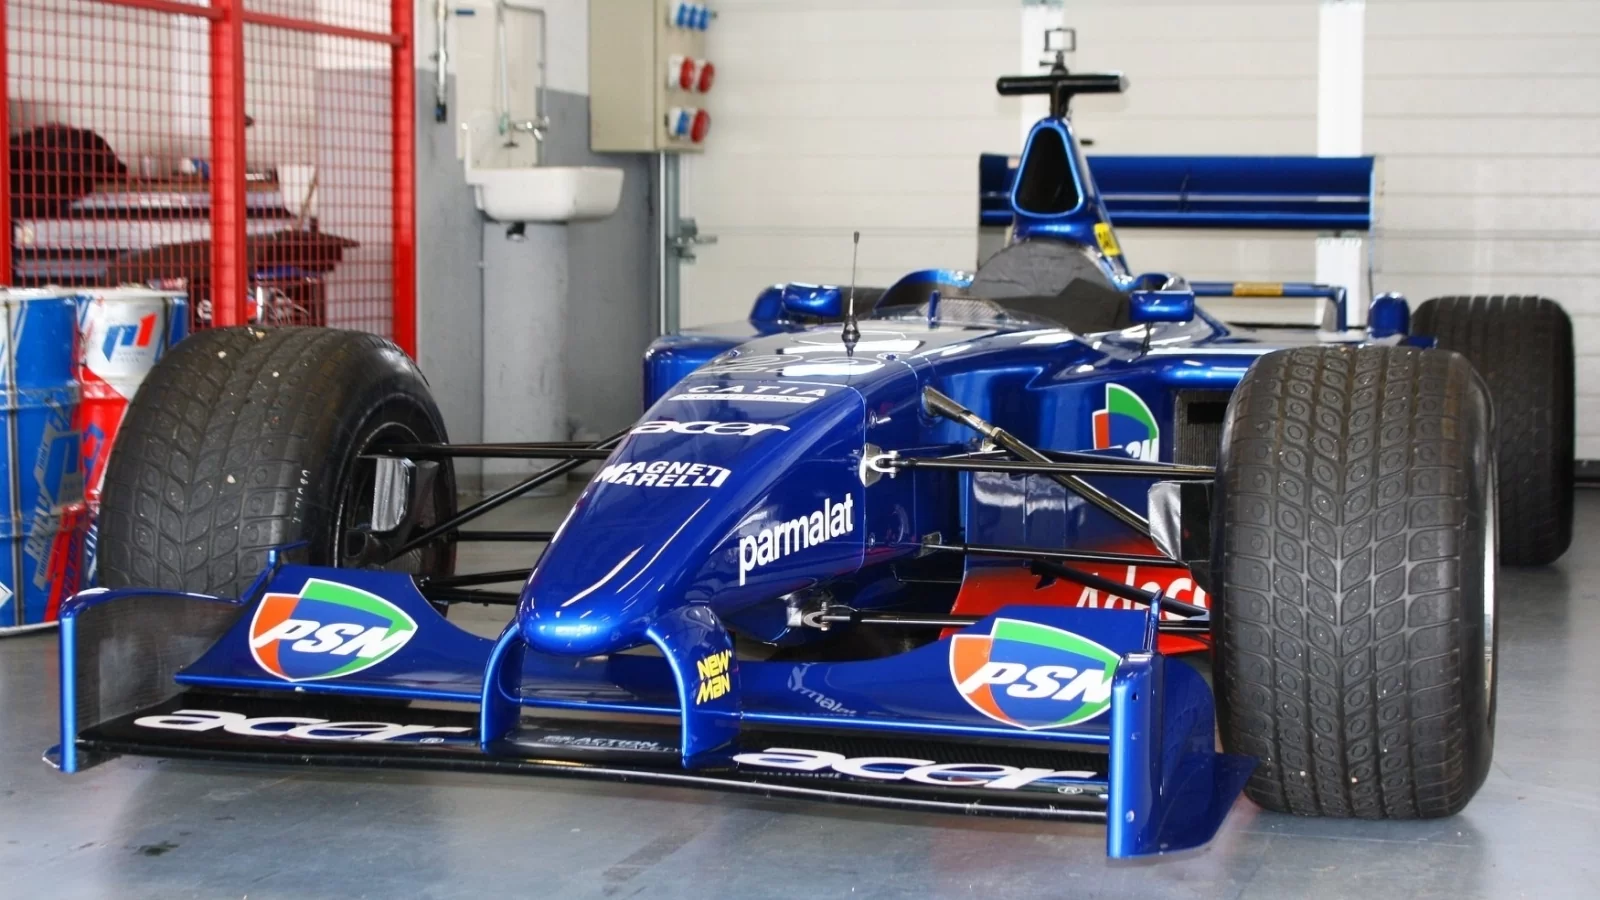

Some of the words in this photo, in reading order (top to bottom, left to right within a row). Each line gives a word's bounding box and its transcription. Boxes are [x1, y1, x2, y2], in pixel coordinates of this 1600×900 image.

[688, 385, 827, 397] CATIA
[629, 420, 790, 436] acer
[594, 470, 728, 487] MARELLI
[739, 493, 853, 587] parmalat
[251, 619, 414, 658] PSN
[960, 661, 1112, 703] PSN
[133, 709, 473, 742] acer
[732, 747, 1098, 789] acer
